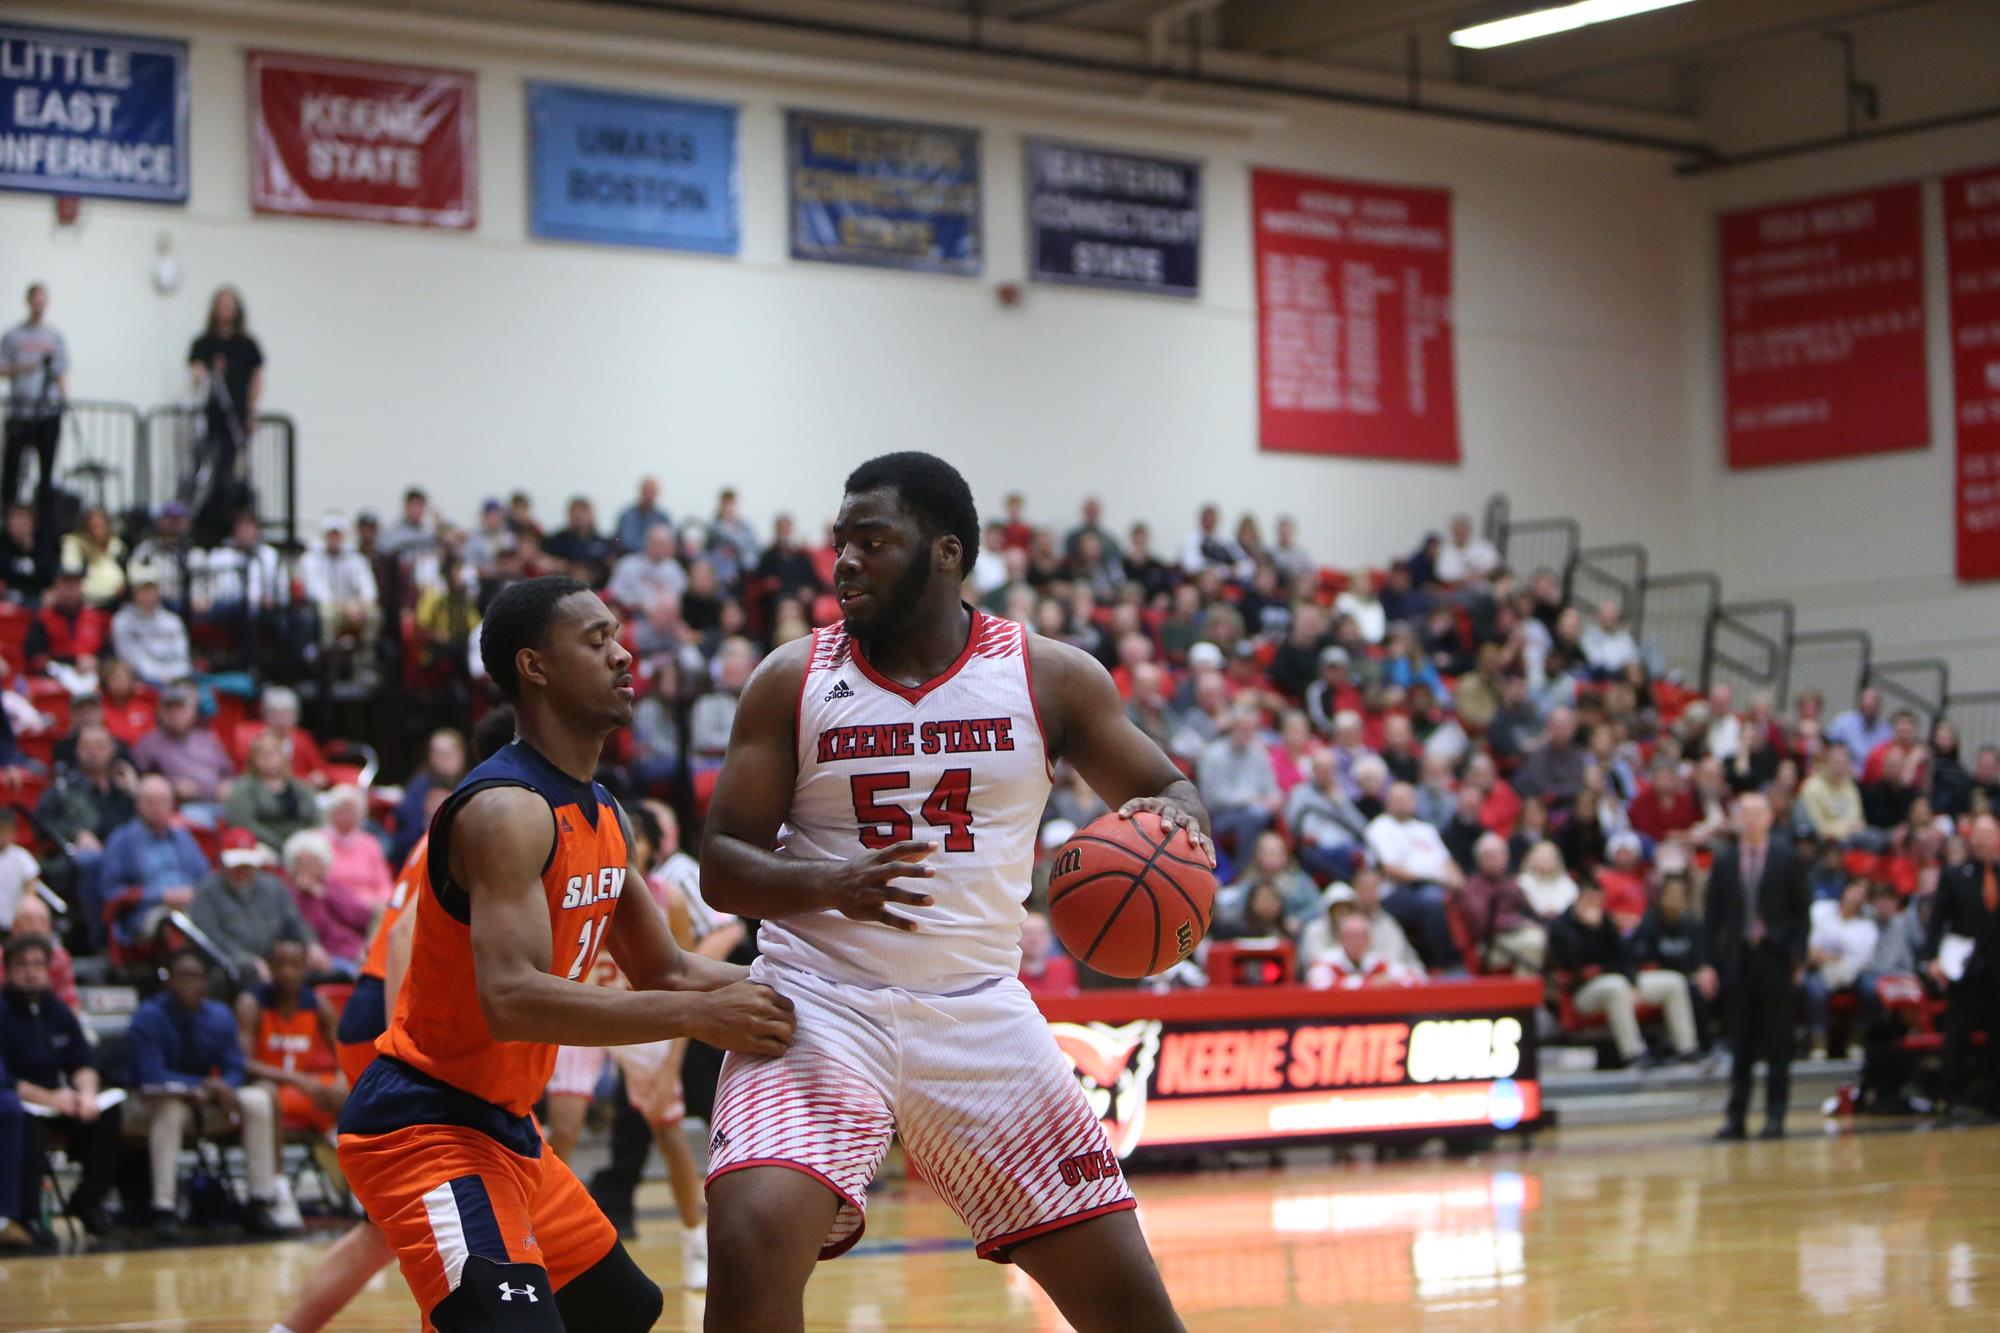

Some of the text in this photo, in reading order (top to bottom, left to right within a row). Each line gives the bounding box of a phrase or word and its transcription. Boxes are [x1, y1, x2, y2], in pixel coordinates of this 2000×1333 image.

[2, 38, 132, 88] LITTLE
[14, 86, 119, 135] EAST
[302, 97, 427, 142] KEENE
[0, 133, 173, 182] NFERENCE
[308, 141, 420, 187] STATE
[576, 127, 696, 164] UMASS
[567, 168, 708, 212] BOSTON
[1043, 150, 1184, 197] EASTERN
[1033, 194, 1200, 243] CONNECTICUT
[1071, 240, 1165, 282] STATE
[824, 688, 855, 703] adidas
[817, 717, 1015, 764] KEENE STATE
[850, 768, 976, 853] 54
[1156, 1028, 1289, 1095] KEENE
[1287, 1022, 1410, 1089] STATE
